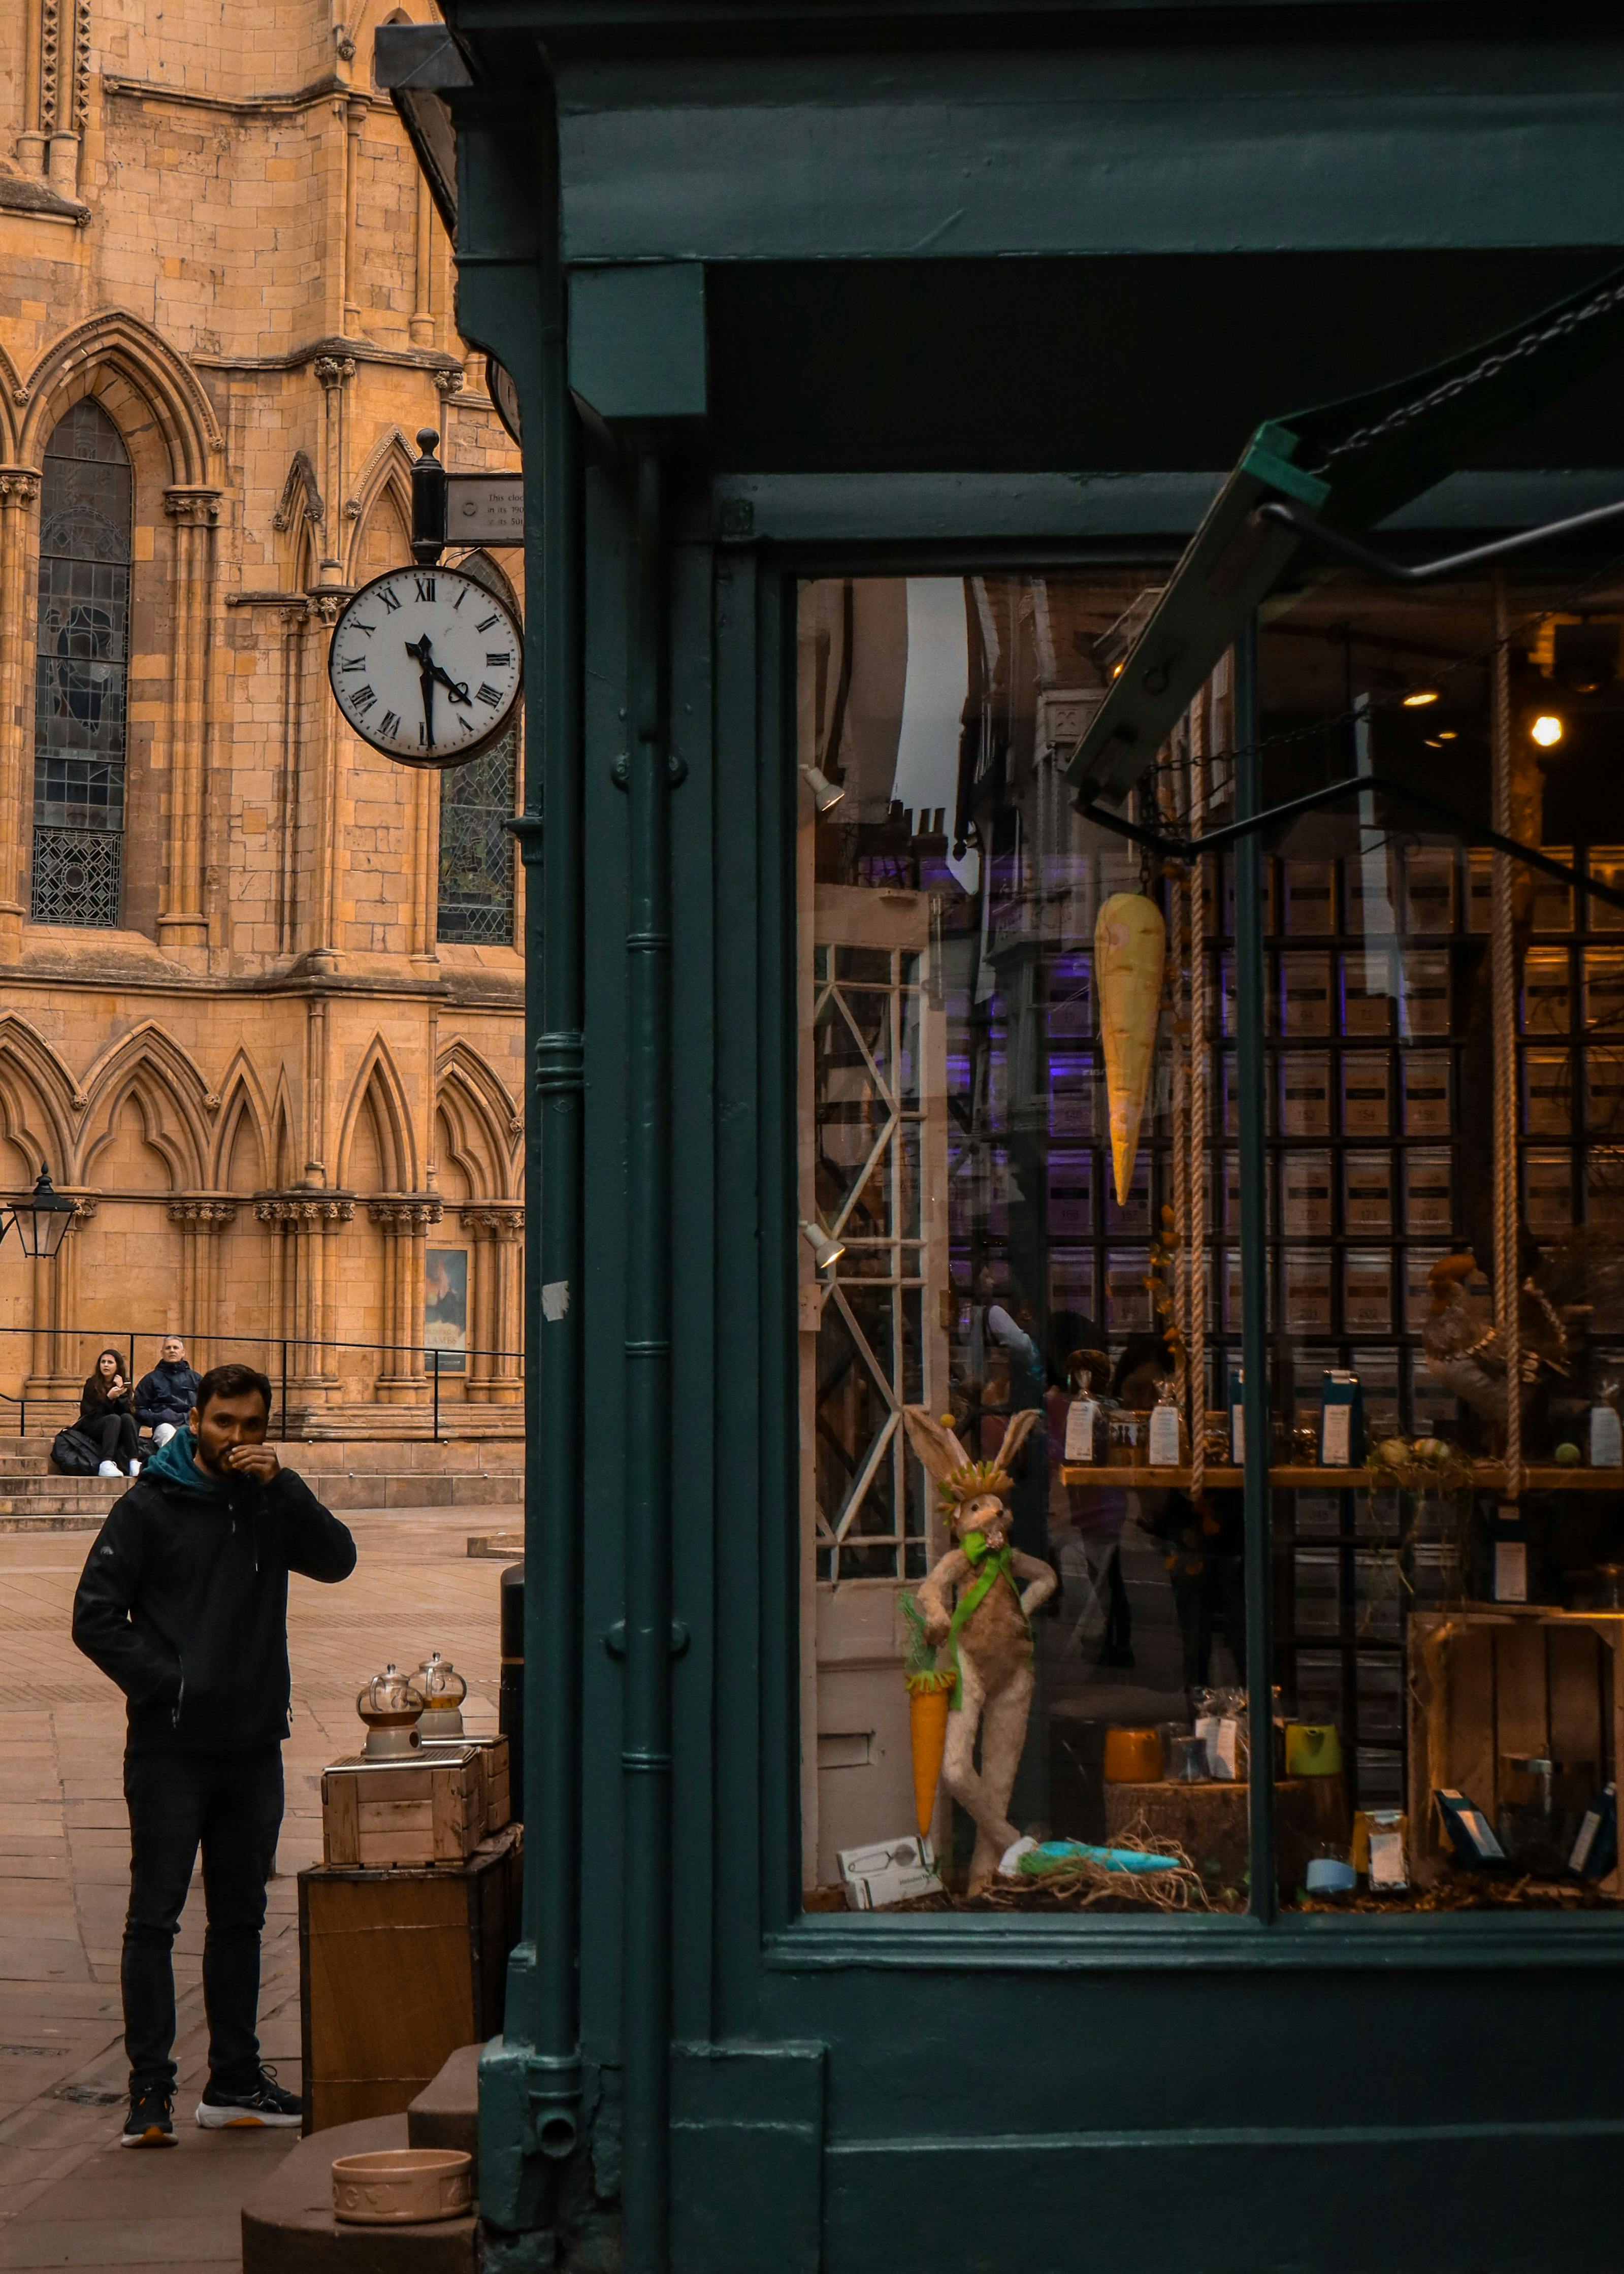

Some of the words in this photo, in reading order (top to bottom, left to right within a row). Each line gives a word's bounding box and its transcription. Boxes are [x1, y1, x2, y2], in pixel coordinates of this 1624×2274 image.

[375, 586, 403, 615] XI
[414, 578, 436, 602] XII
[454, 587, 469, 609] I
[349, 616, 376, 638] X
[475, 613, 500, 634] II
[342, 655, 366, 673] IX
[486, 653, 510, 667] III
[457, 713, 475, 736] V
[425, 1337, 457, 1346] LAMES
